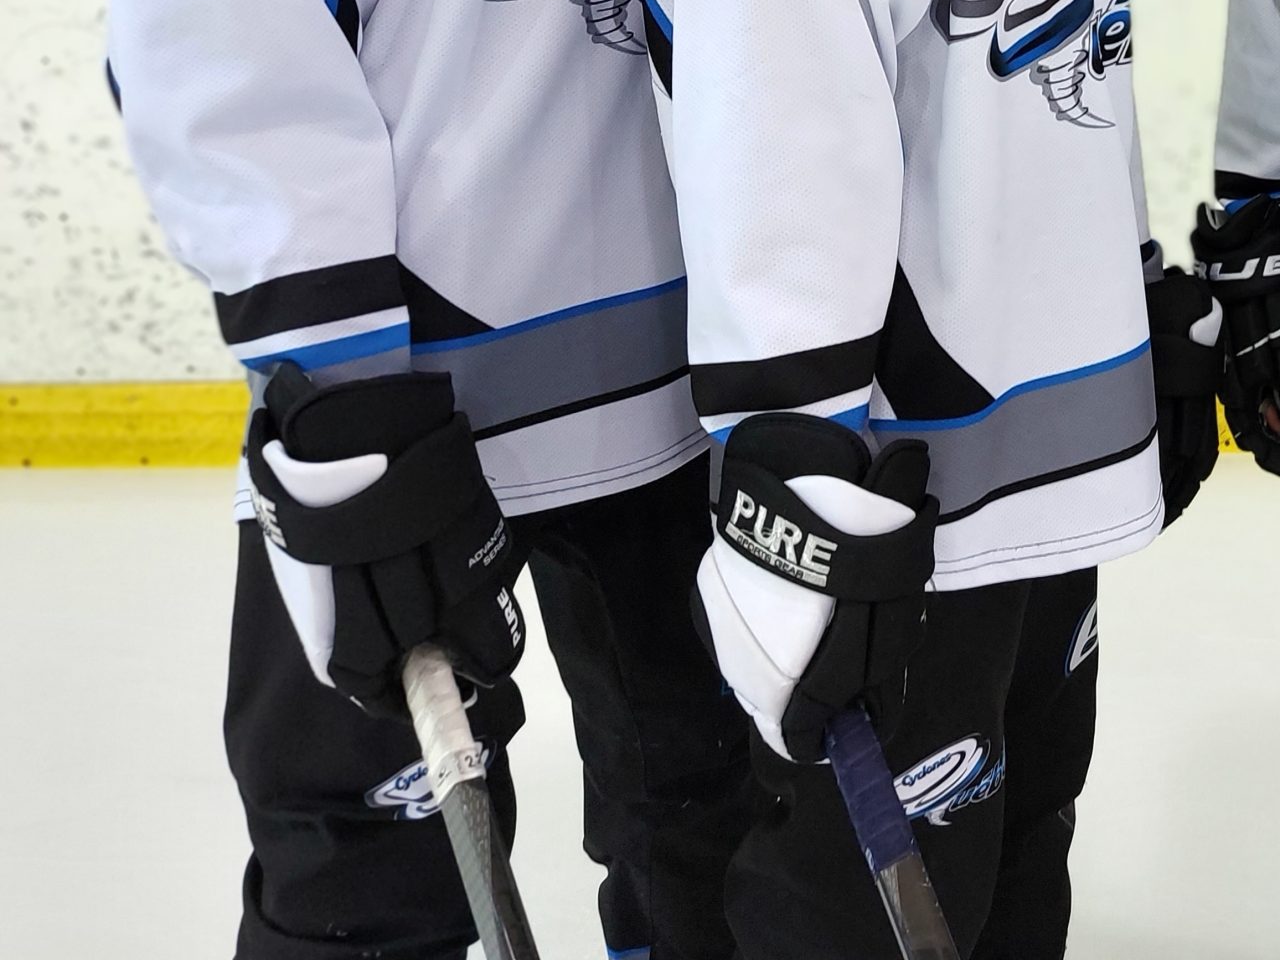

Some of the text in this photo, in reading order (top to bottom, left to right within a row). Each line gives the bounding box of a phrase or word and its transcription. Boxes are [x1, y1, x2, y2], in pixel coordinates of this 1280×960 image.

[730, 489, 838, 576] PURE
[775, 558, 804, 579] GEAR
[496, 586, 522, 649] PURE
[395, 766, 428, 791] Cyclo
